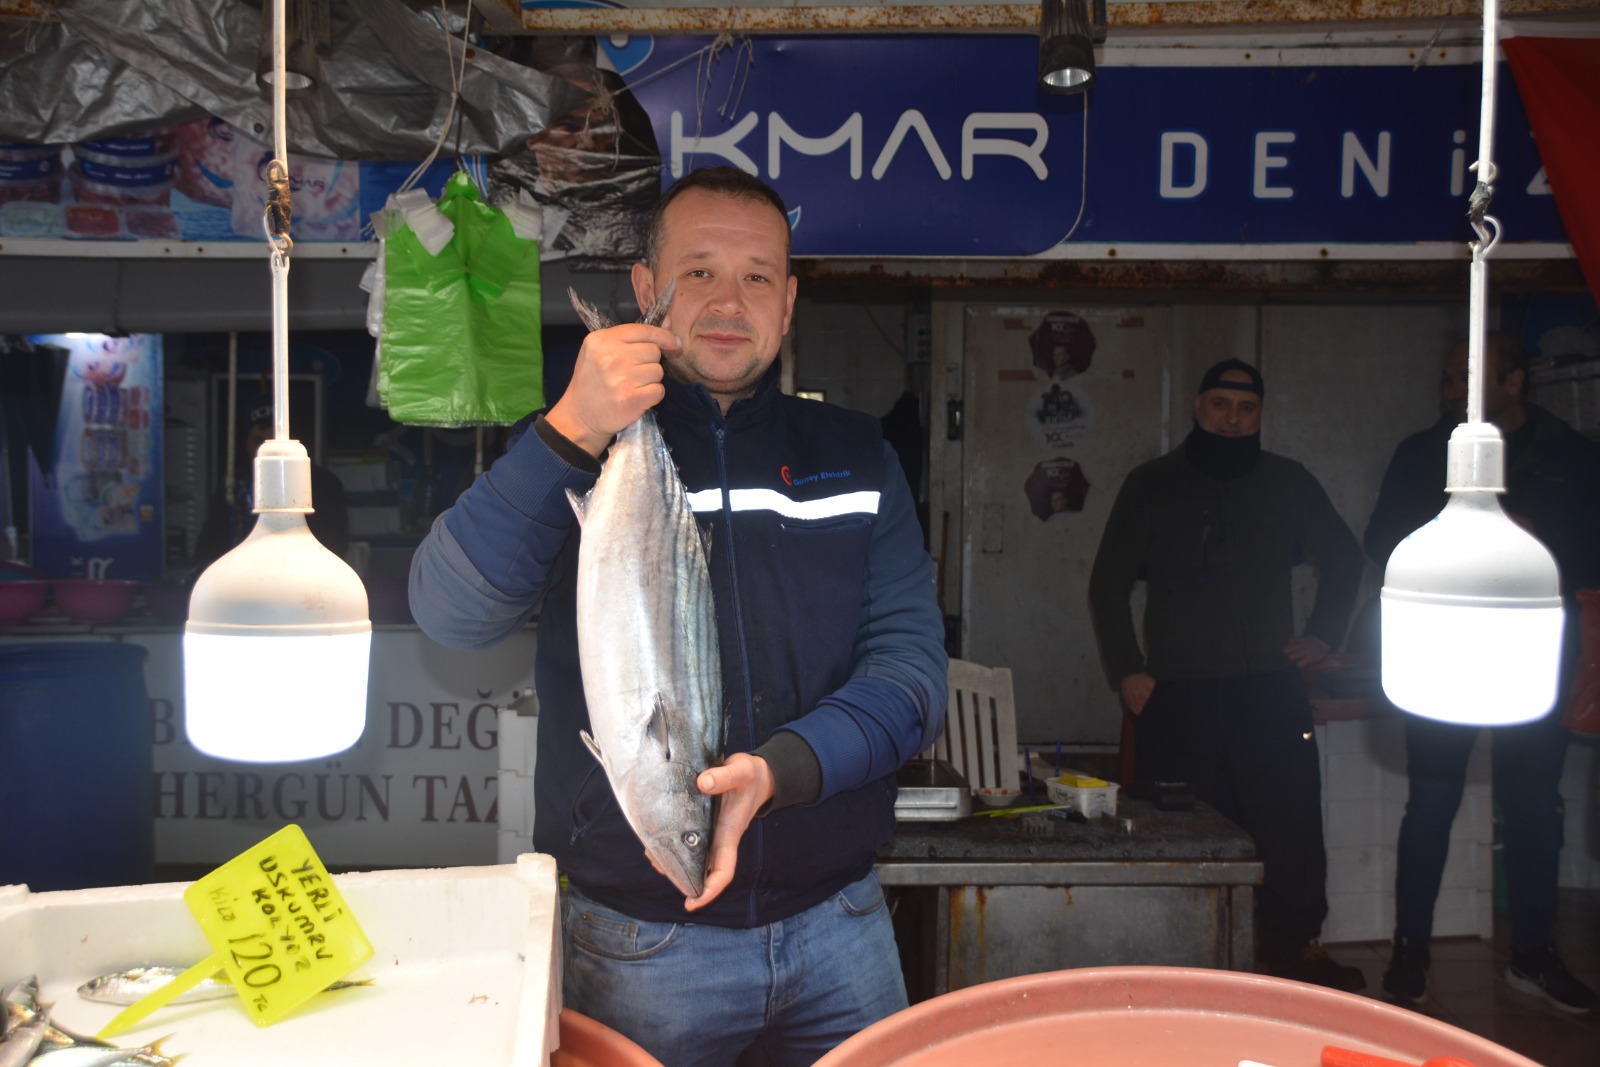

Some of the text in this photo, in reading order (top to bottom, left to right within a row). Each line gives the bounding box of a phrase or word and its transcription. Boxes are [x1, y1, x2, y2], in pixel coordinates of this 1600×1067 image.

[671, 109, 1049, 180] KMAR
[153, 761, 394, 822] HERGÜN
[228, 932, 282, 988] 120
